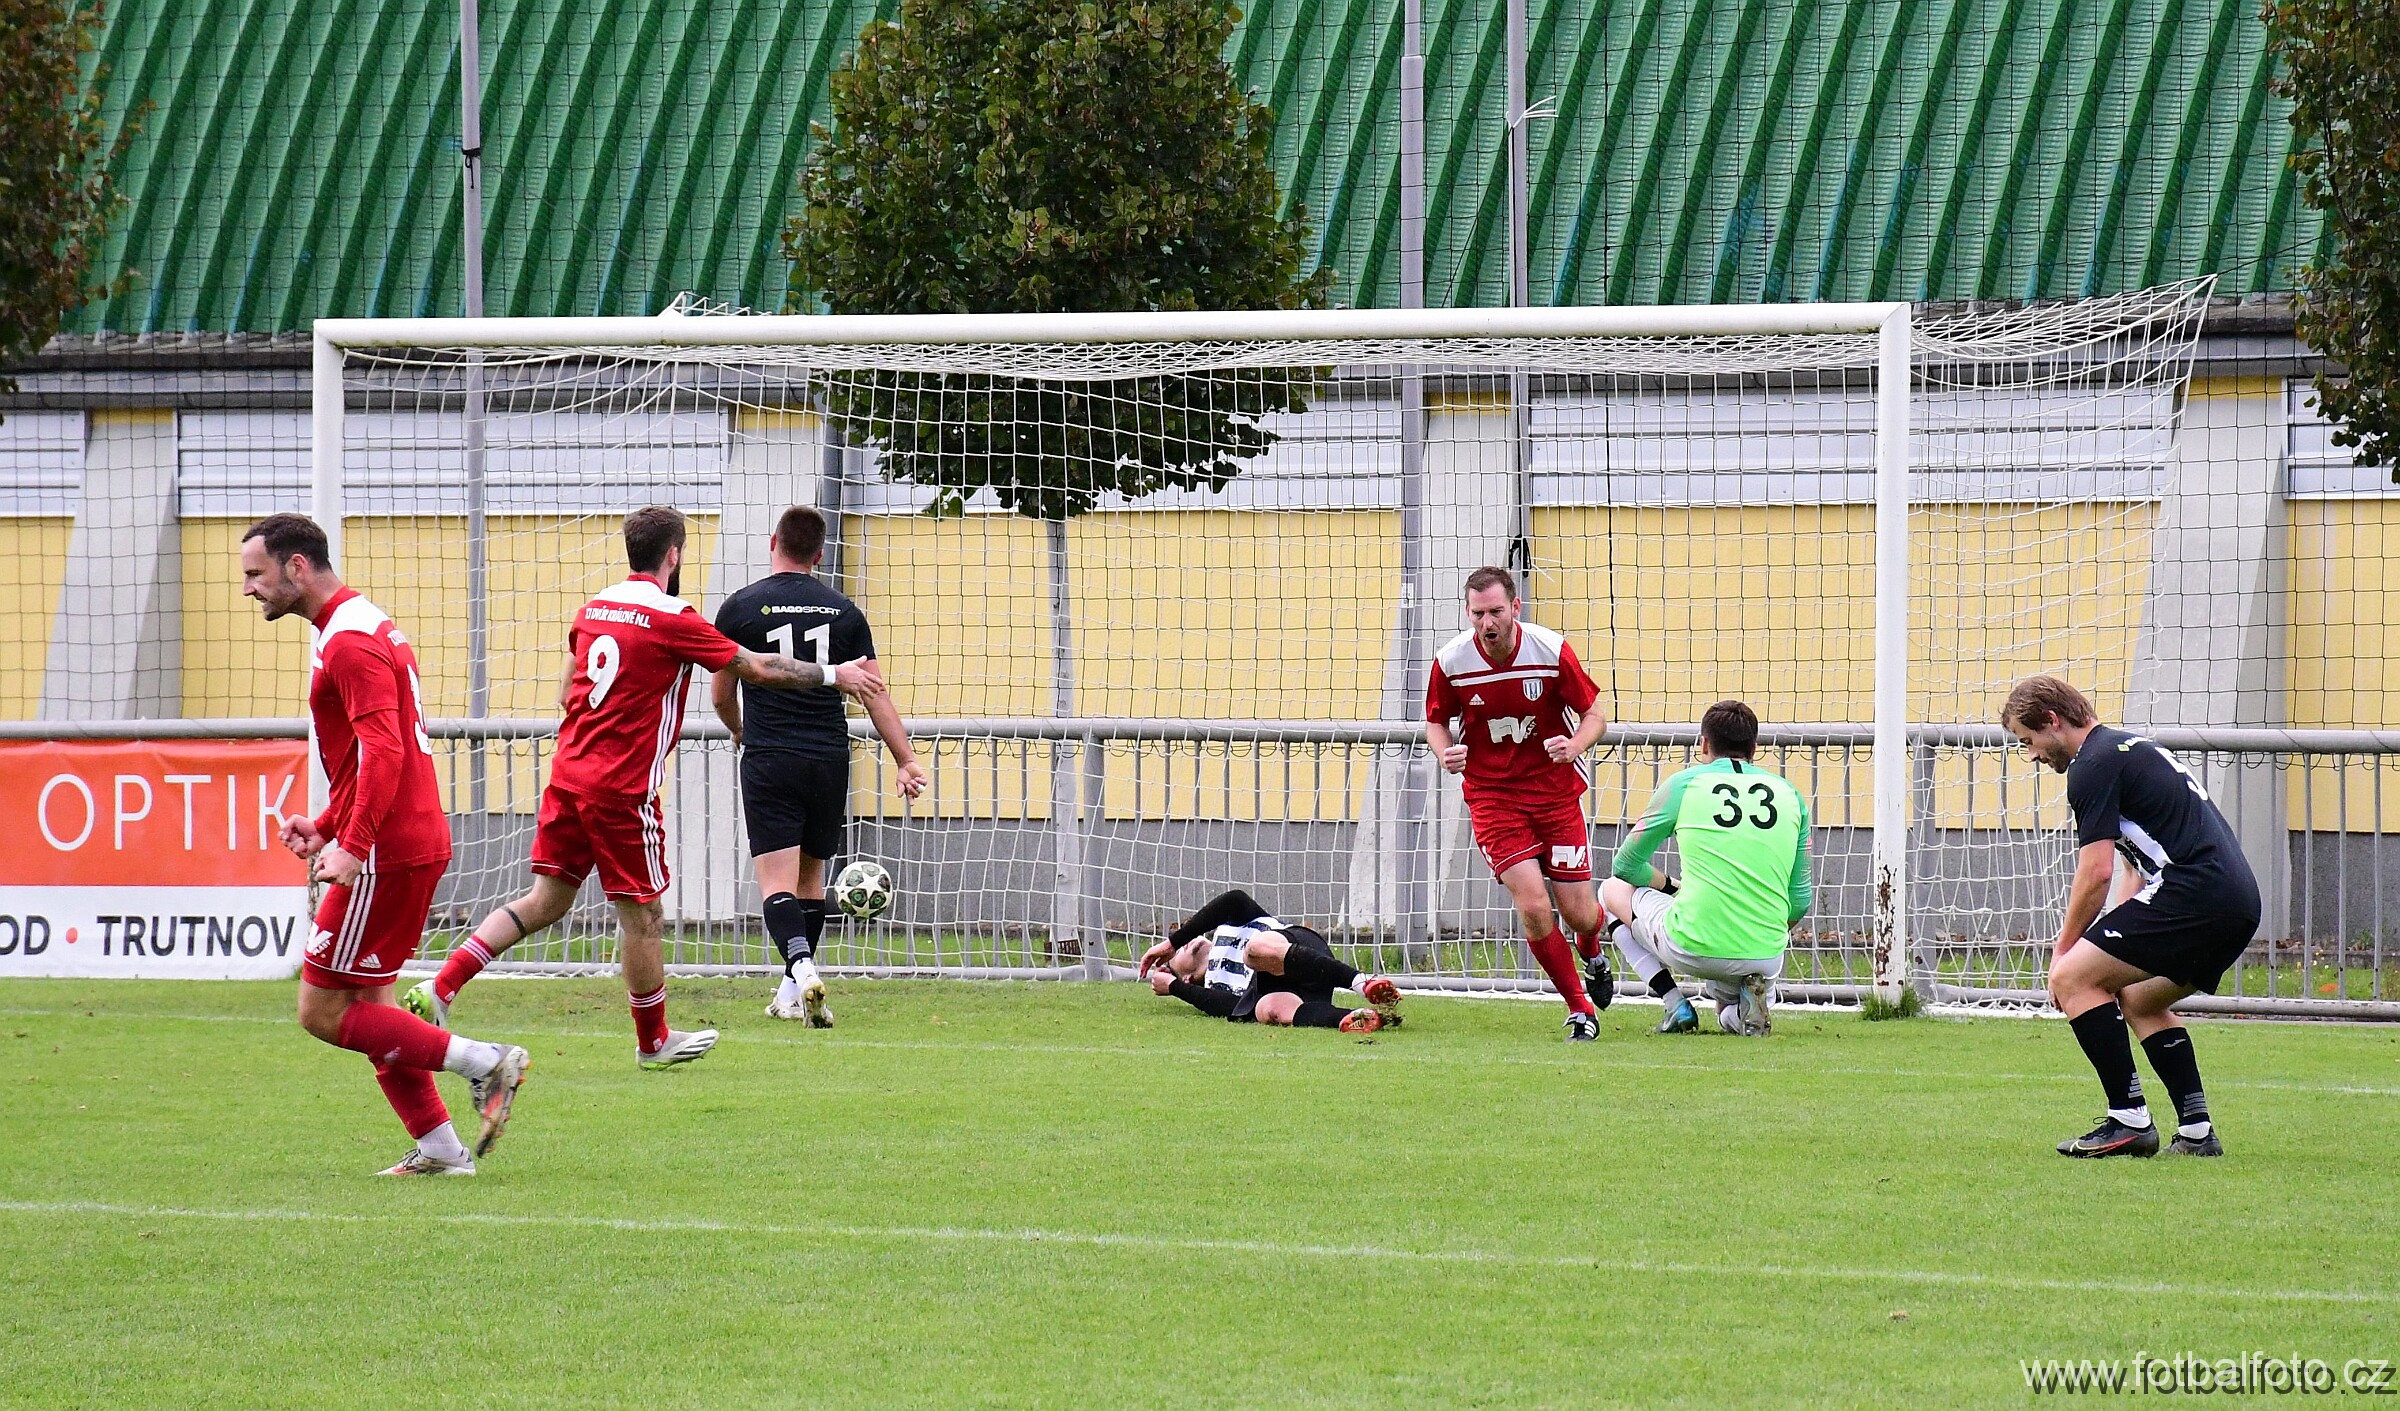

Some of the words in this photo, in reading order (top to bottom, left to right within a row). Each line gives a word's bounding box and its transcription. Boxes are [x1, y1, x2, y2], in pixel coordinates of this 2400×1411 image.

[766, 623, 830, 666] 11
[587, 634, 620, 709] 9
[1711, 783, 1778, 829] 33
[97, 915, 296, 957] TRUTNOV
